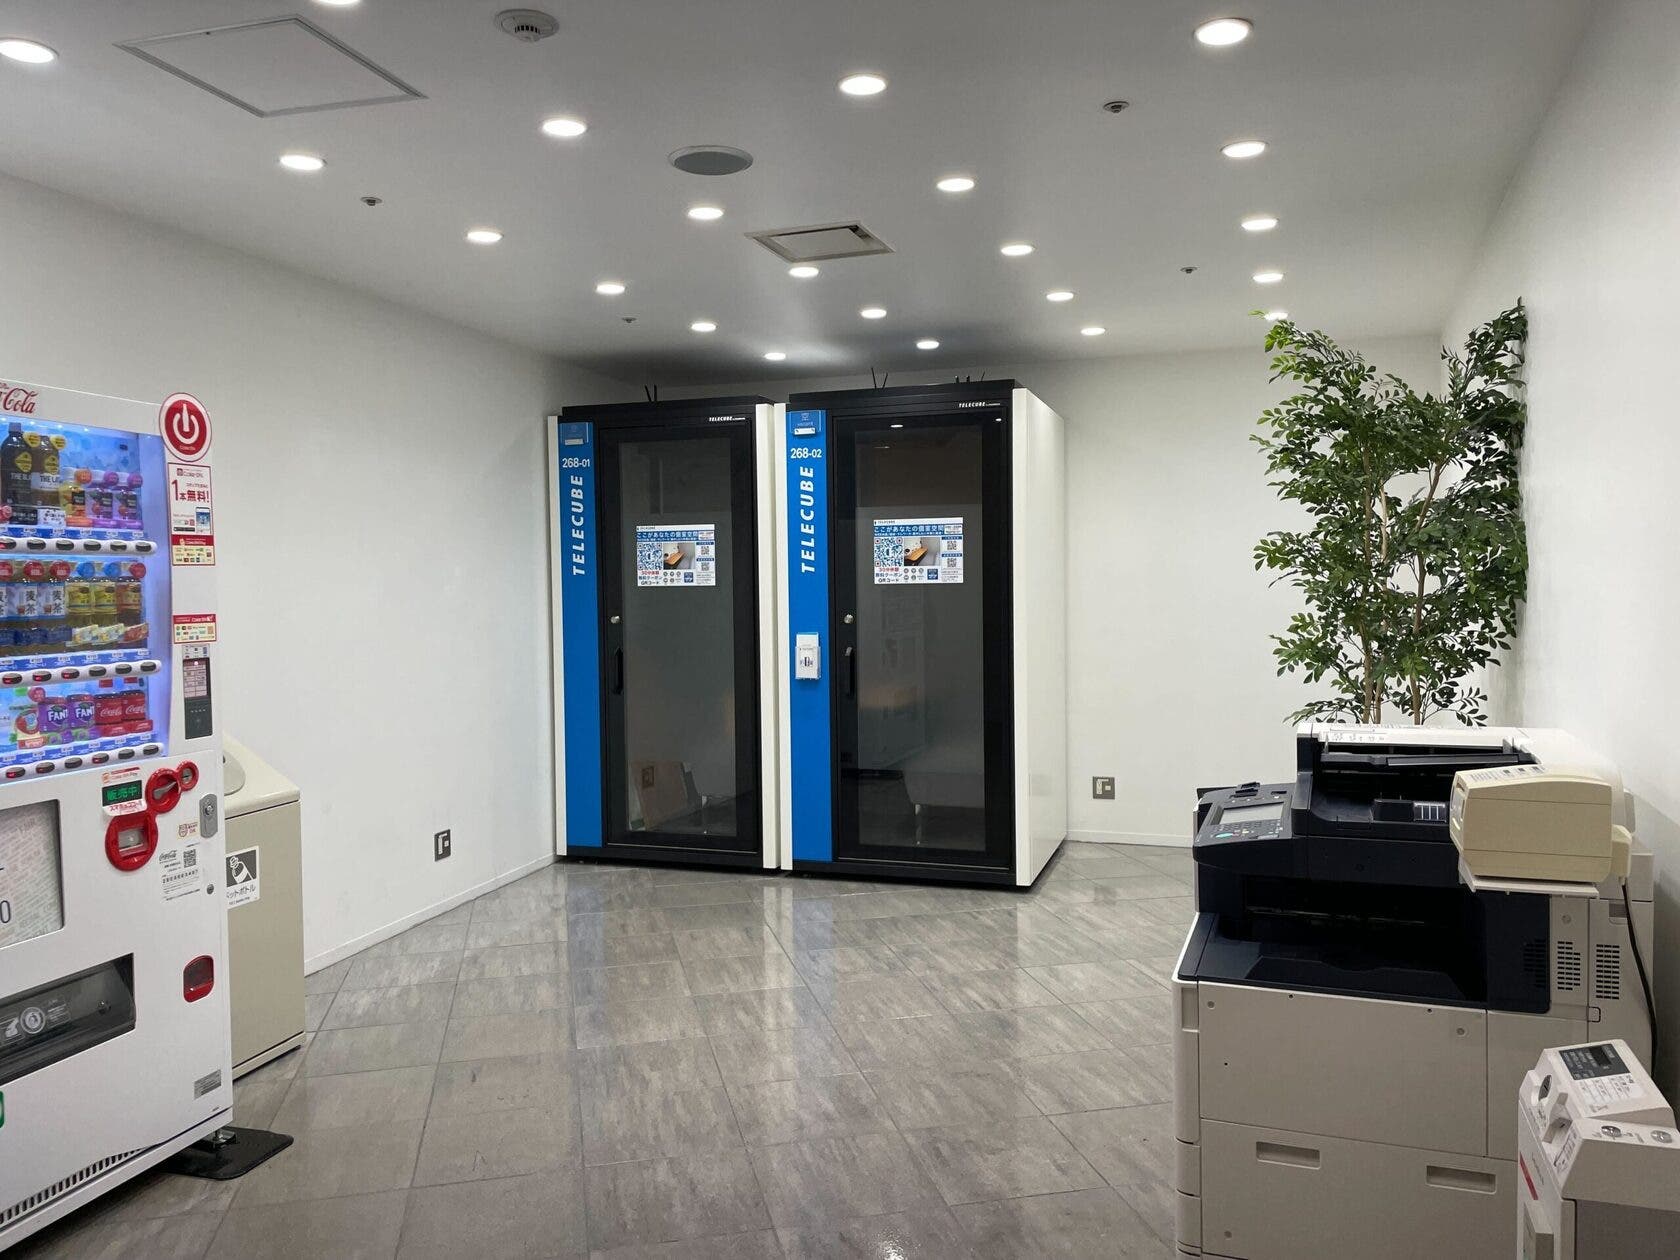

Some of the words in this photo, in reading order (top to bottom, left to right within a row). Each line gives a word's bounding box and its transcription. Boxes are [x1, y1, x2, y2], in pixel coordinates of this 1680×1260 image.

[562, 457, 591, 469] 268-01
[790, 447, 823, 459] 268-02
[570, 475, 585, 576] TELECUBE
[800, 466, 815, 573] TELECUBE
[26, 590, 36, 616] 麦茶
[52, 590, 63, 616] 麦茶
